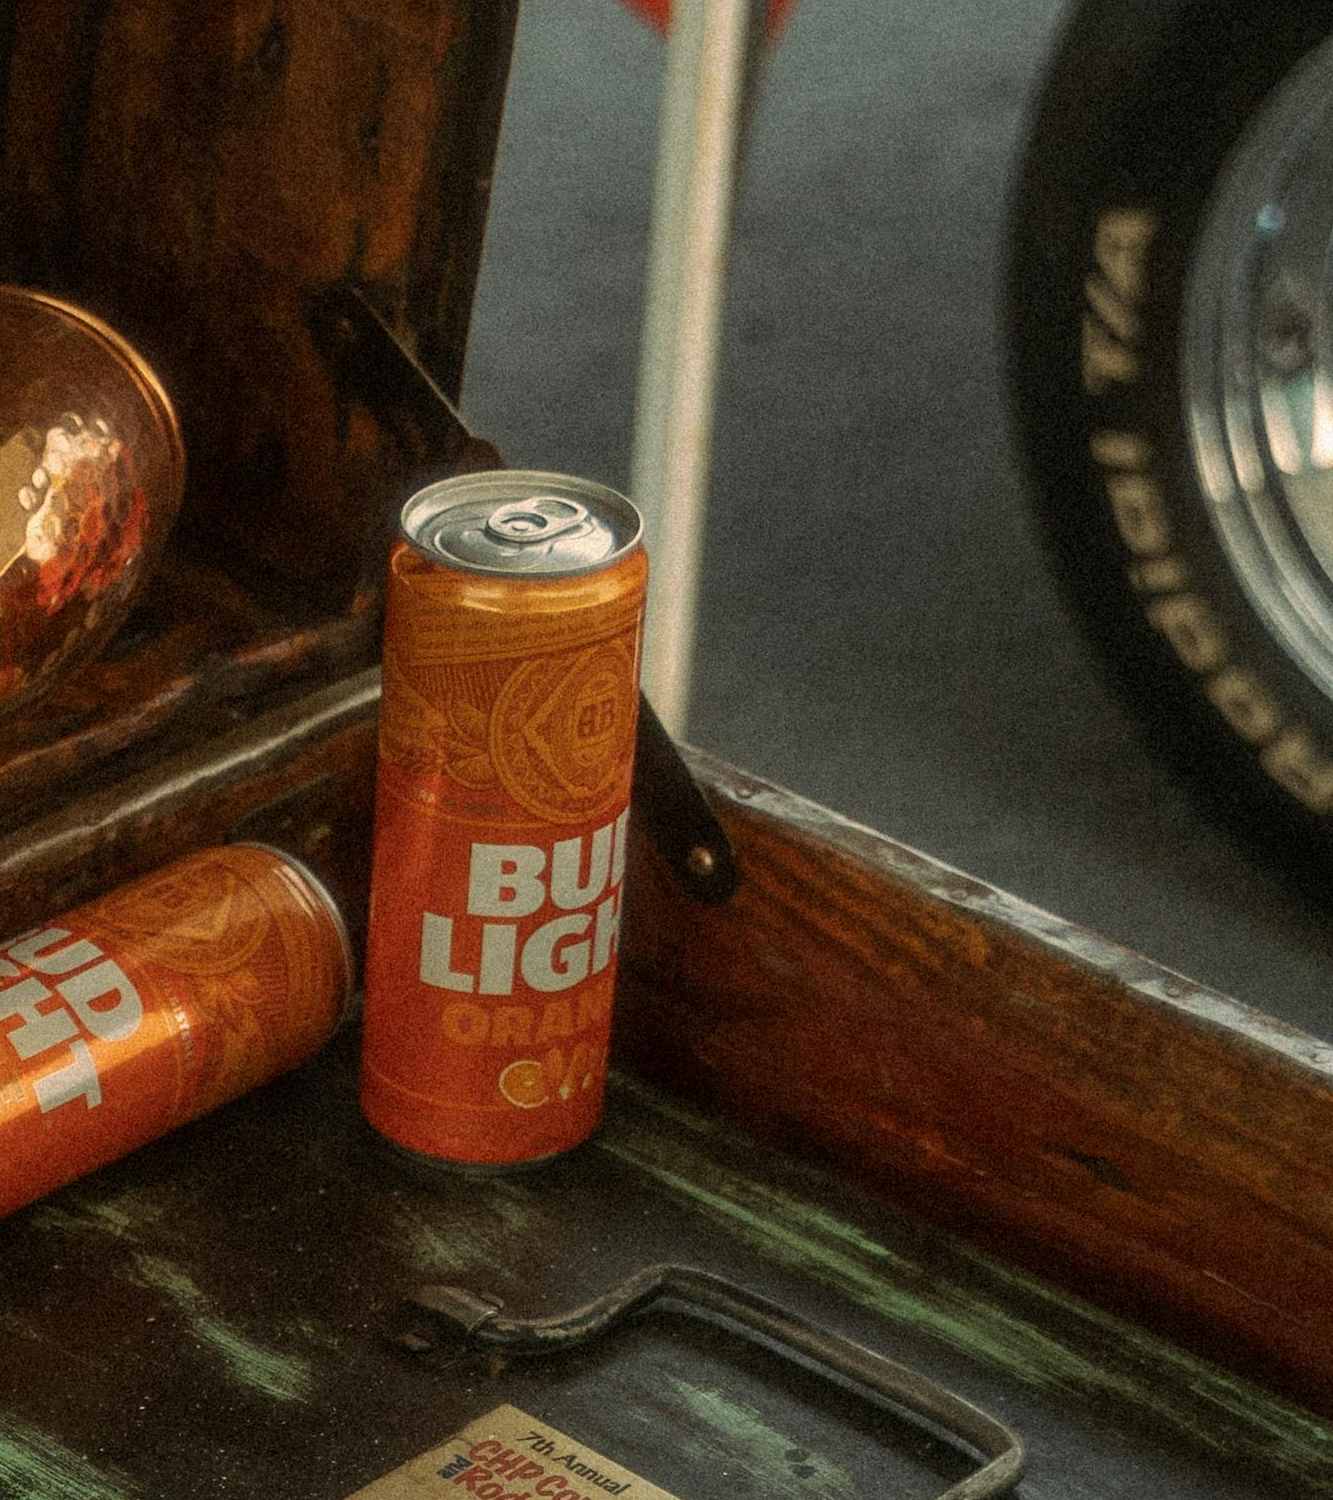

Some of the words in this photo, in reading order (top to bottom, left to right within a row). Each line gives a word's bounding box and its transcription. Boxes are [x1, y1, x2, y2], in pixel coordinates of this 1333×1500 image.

[419, 884, 622, 995] LIGH
[468, 1440, 544, 1482] CHP
[517, 1431, 554, 1458] 7th
[553, 1452, 631, 1496] Annual
